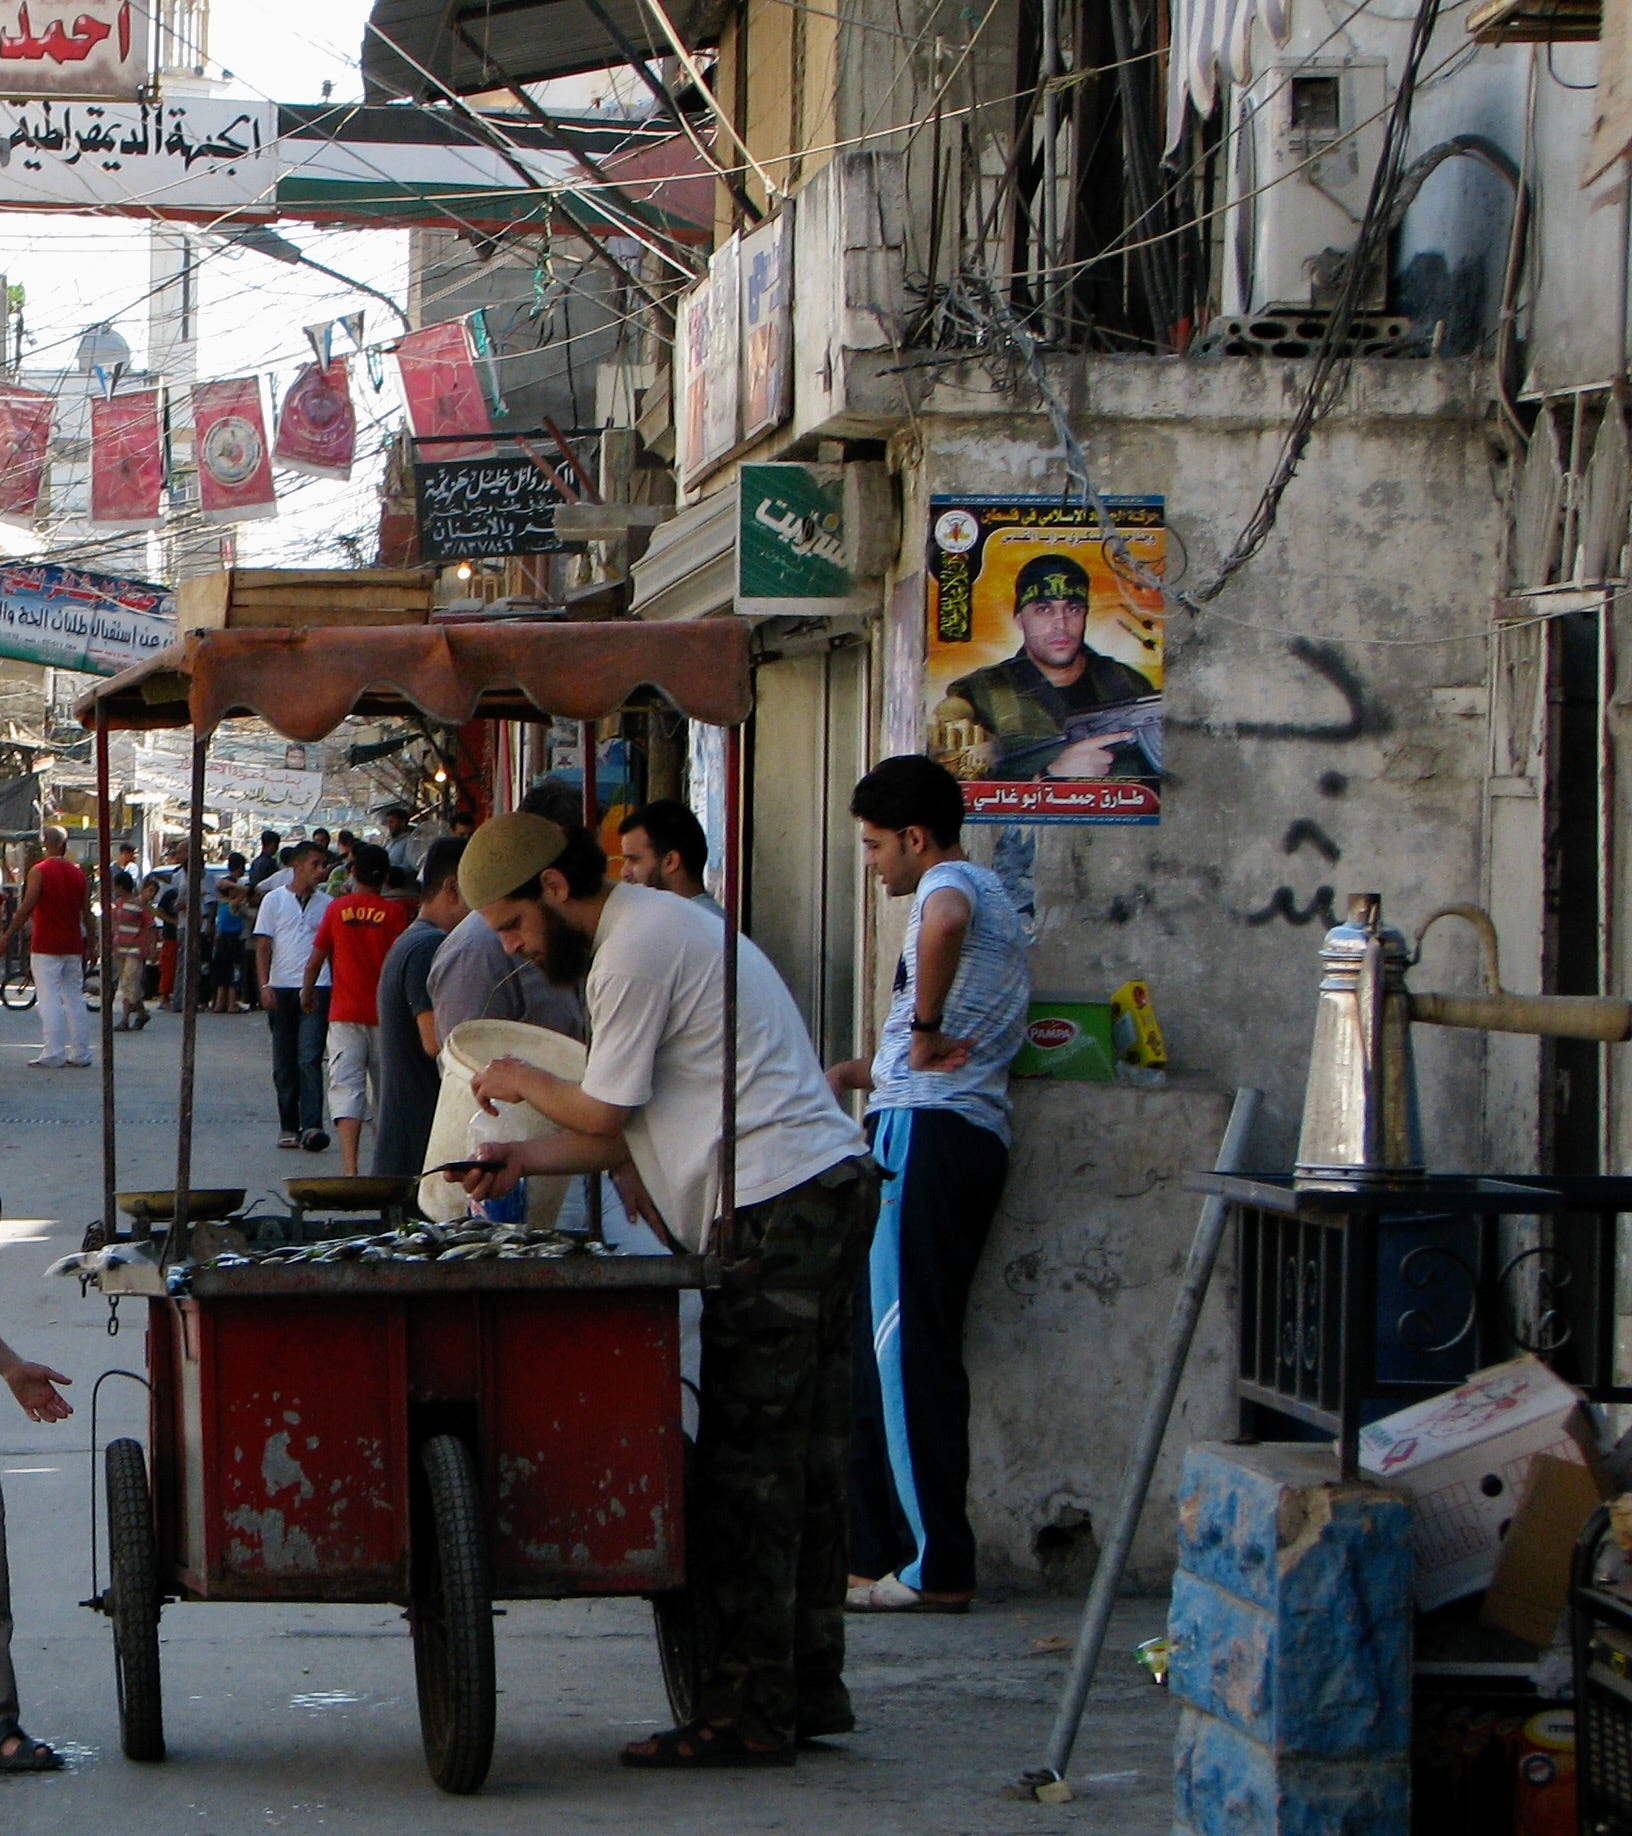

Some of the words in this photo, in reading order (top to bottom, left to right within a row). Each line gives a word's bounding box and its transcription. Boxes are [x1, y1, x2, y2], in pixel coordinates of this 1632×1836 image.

[9, 98, 165, 172] الديمقراطية
[165, 107, 261, 175] الجبهة
[973, 787, 1017, 811] غالي
[1020, 786, 1044, 809] أبو
[1045, 787, 1097, 808] جمعة
[1099, 789, 1145, 808] طارق
[341, 906, 386, 924] MOTO
[1029, 1026, 1071, 1040] PAMPA
